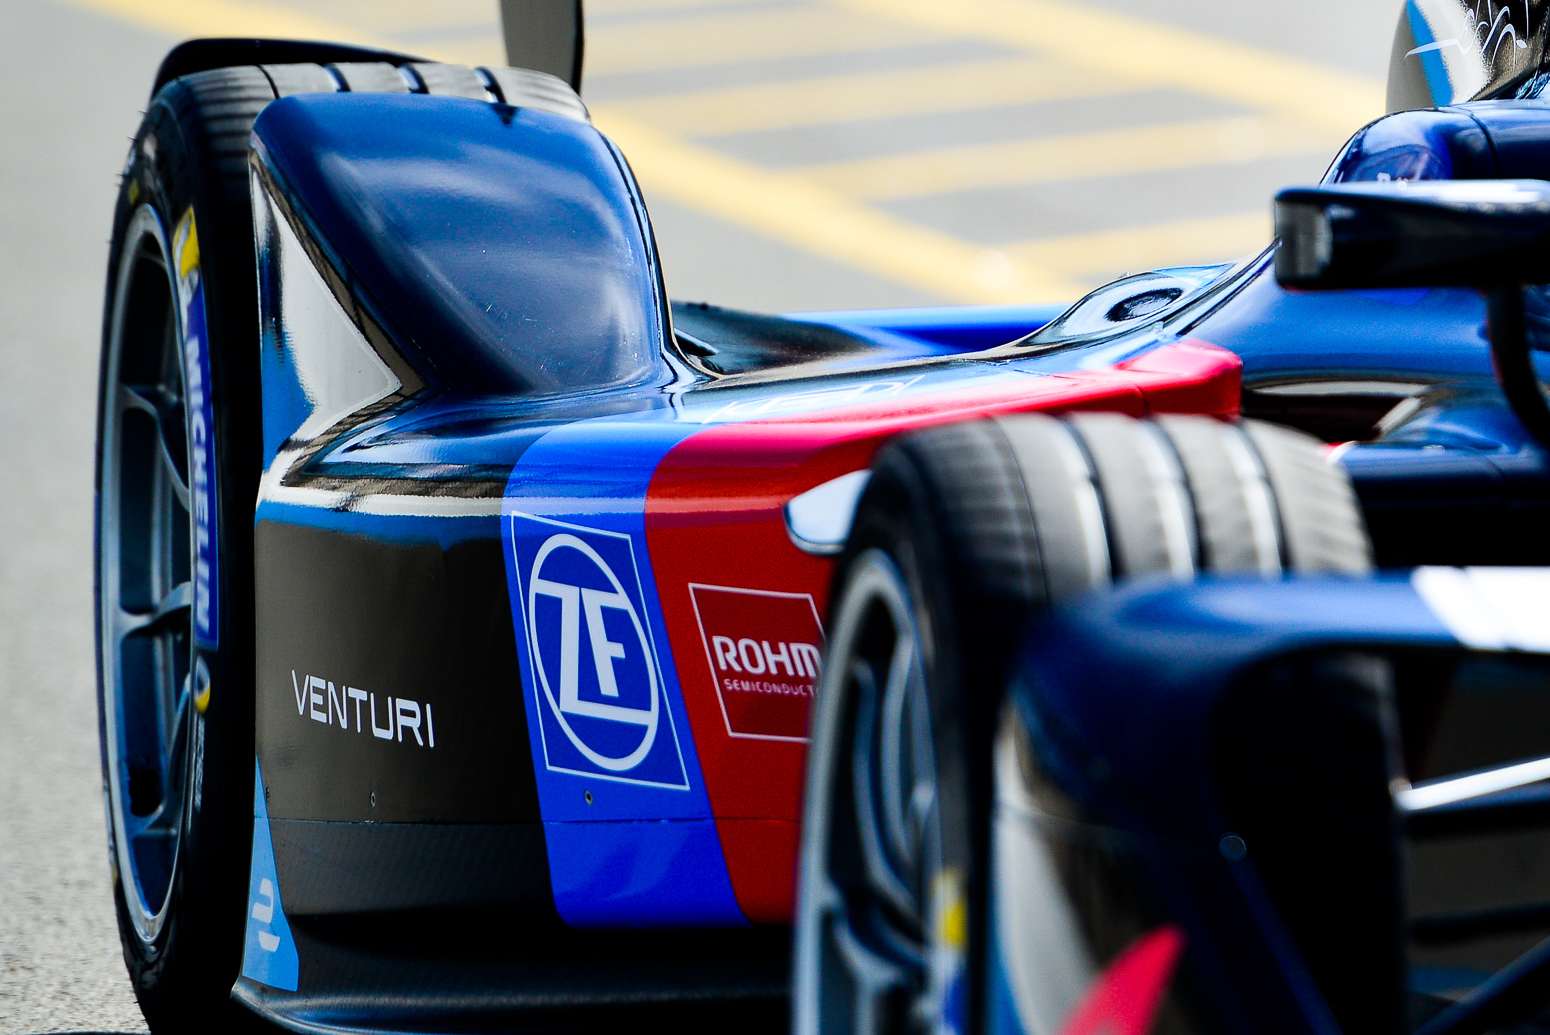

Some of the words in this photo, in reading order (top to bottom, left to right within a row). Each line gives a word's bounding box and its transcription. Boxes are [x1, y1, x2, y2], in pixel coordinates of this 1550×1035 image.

[186, 335, 210, 633] MICHELIN
[529, 572, 658, 732] ZF
[712, 635, 822, 678] ROHM
[723, 678, 816, 698] SEMICONDUCT
[292, 669, 435, 748] VENTURI
